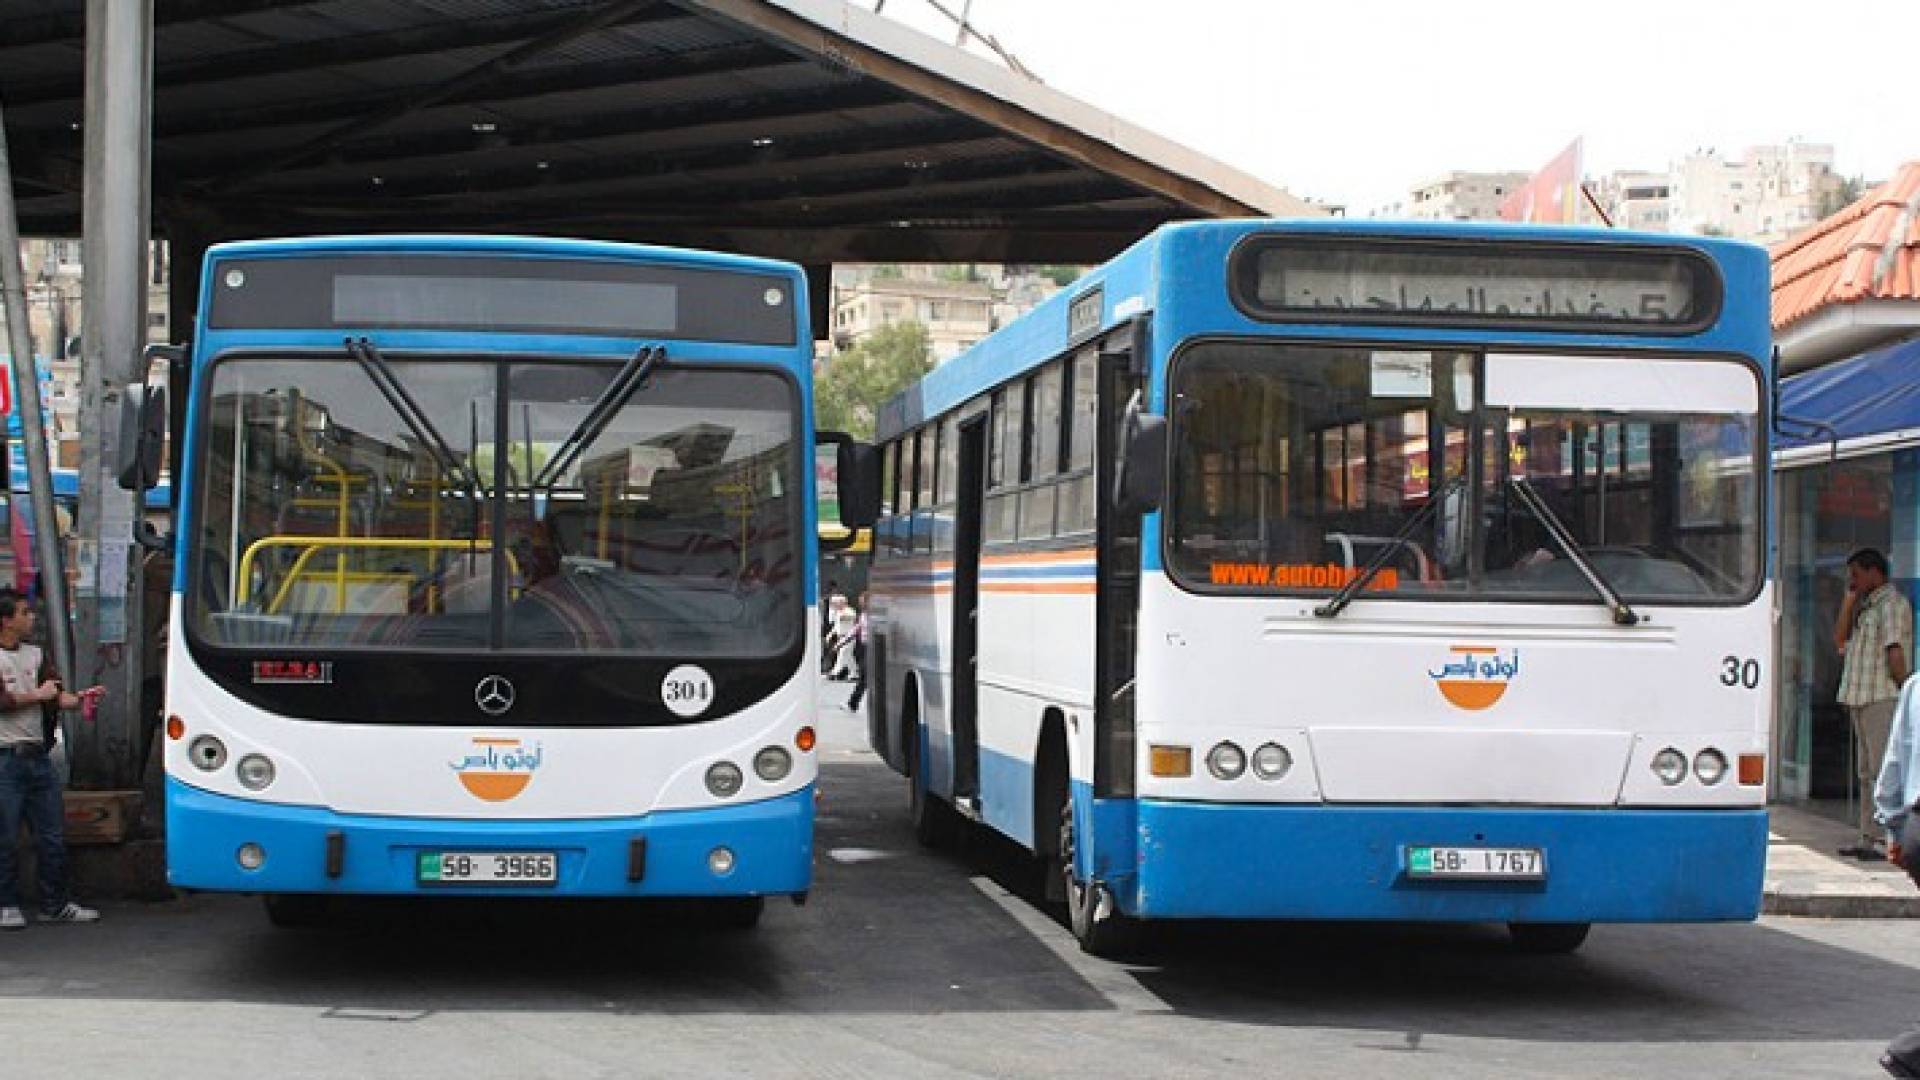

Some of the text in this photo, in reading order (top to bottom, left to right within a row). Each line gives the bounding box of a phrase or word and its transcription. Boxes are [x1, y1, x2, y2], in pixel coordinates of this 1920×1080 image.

[1719, 655, 1761, 689] 30
[666, 680, 709, 702] 304
[493, 855, 552, 878] 3966
[1484, 851, 1537, 872] 1767
